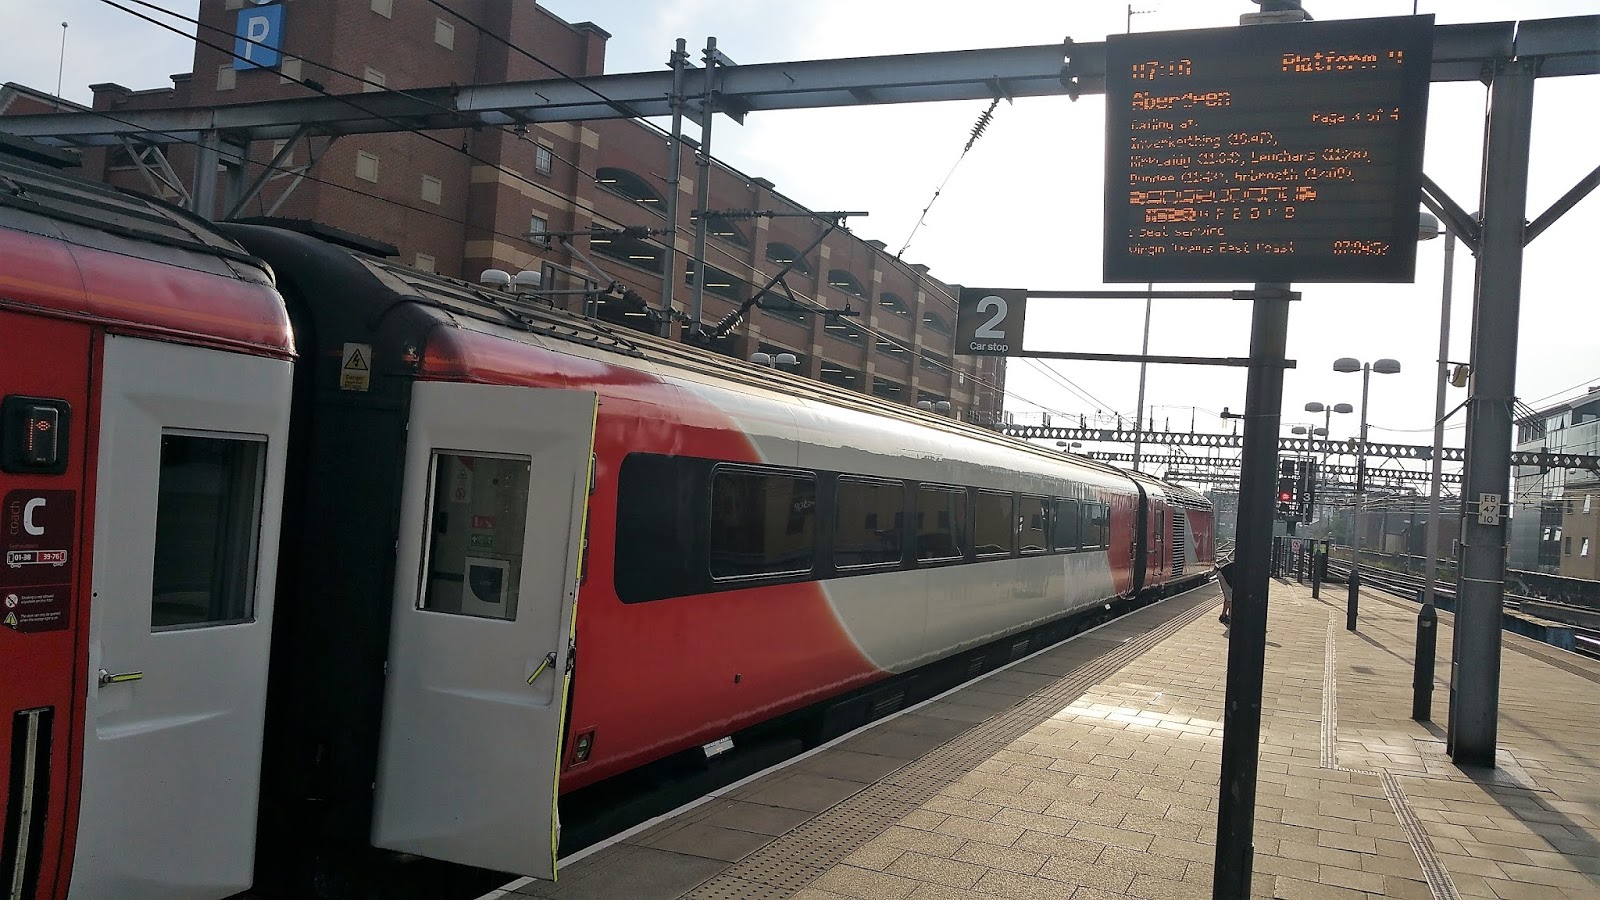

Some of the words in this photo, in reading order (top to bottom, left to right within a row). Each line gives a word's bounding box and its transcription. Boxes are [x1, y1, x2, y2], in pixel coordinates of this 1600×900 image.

[245, 16, 270, 60] P
[1282, 50, 1378, 73] Platform
[1132, 91, 1232, 111] Aberdeen
[974, 295, 1008, 339] 2
[969, 341, 986, 351] Car
[987, 342, 1009, 353] stop
[1302, 492, 1311, 502] 3
[1484, 494, 1497, 503] EB
[9, 500, 20, 535] coach
[23, 497, 47, 535] C
[1483, 505, 1497, 513] 47
